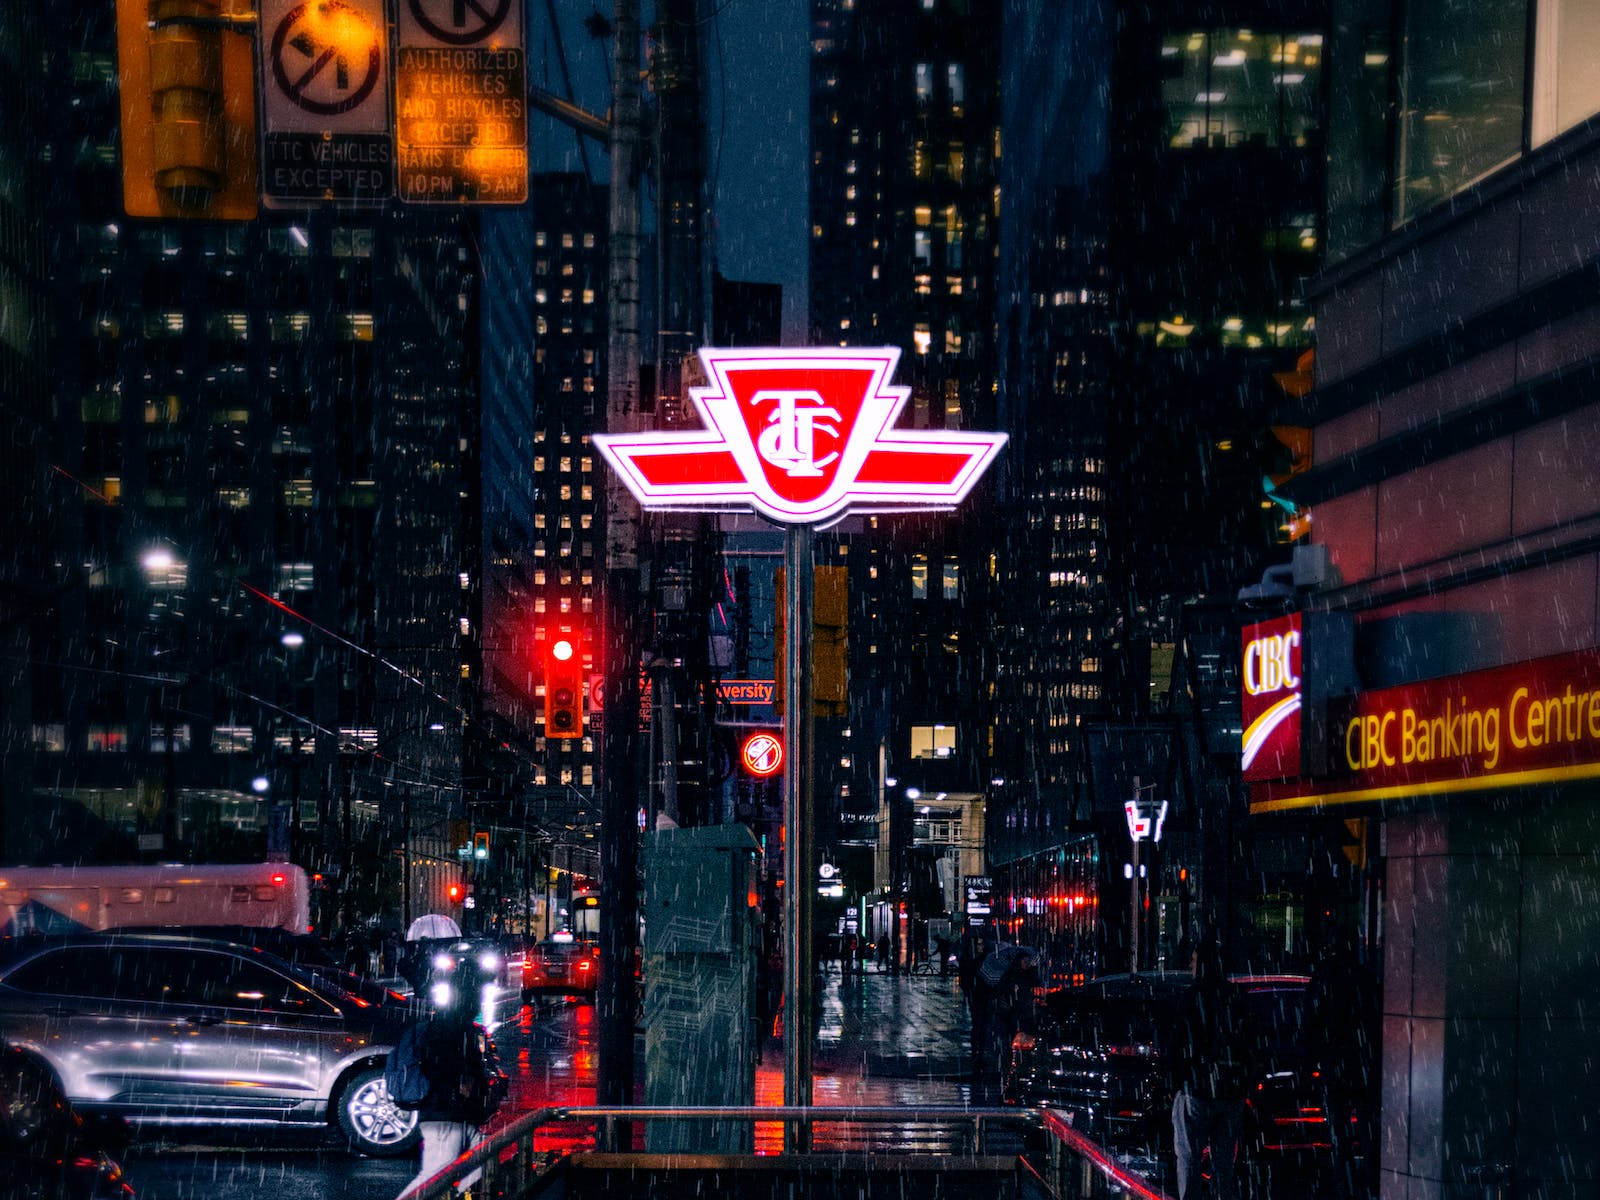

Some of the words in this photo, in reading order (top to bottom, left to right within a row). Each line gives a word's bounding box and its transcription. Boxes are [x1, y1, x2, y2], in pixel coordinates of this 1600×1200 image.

[404, 51, 518, 70] AUTHORIZED
[416, 74, 506, 95] VEHICLES
[403, 99, 437, 118] AND
[446, 99, 521, 118] BICYCLES
[416, 123, 509, 143] EXCEPTED
[269, 141, 302, 160] TTC
[310, 141, 389, 162] VEHICLES
[403, 149, 443, 168] TAXIS
[275, 167, 383, 189] EXCEPTED
[1243, 630, 1300, 696] CIBC
[716, 682, 773, 702] versity
[1346, 711, 1396, 771] CIBC
[1401, 696, 1500, 769] Banking
[1509, 684, 1600, 749] Centre
